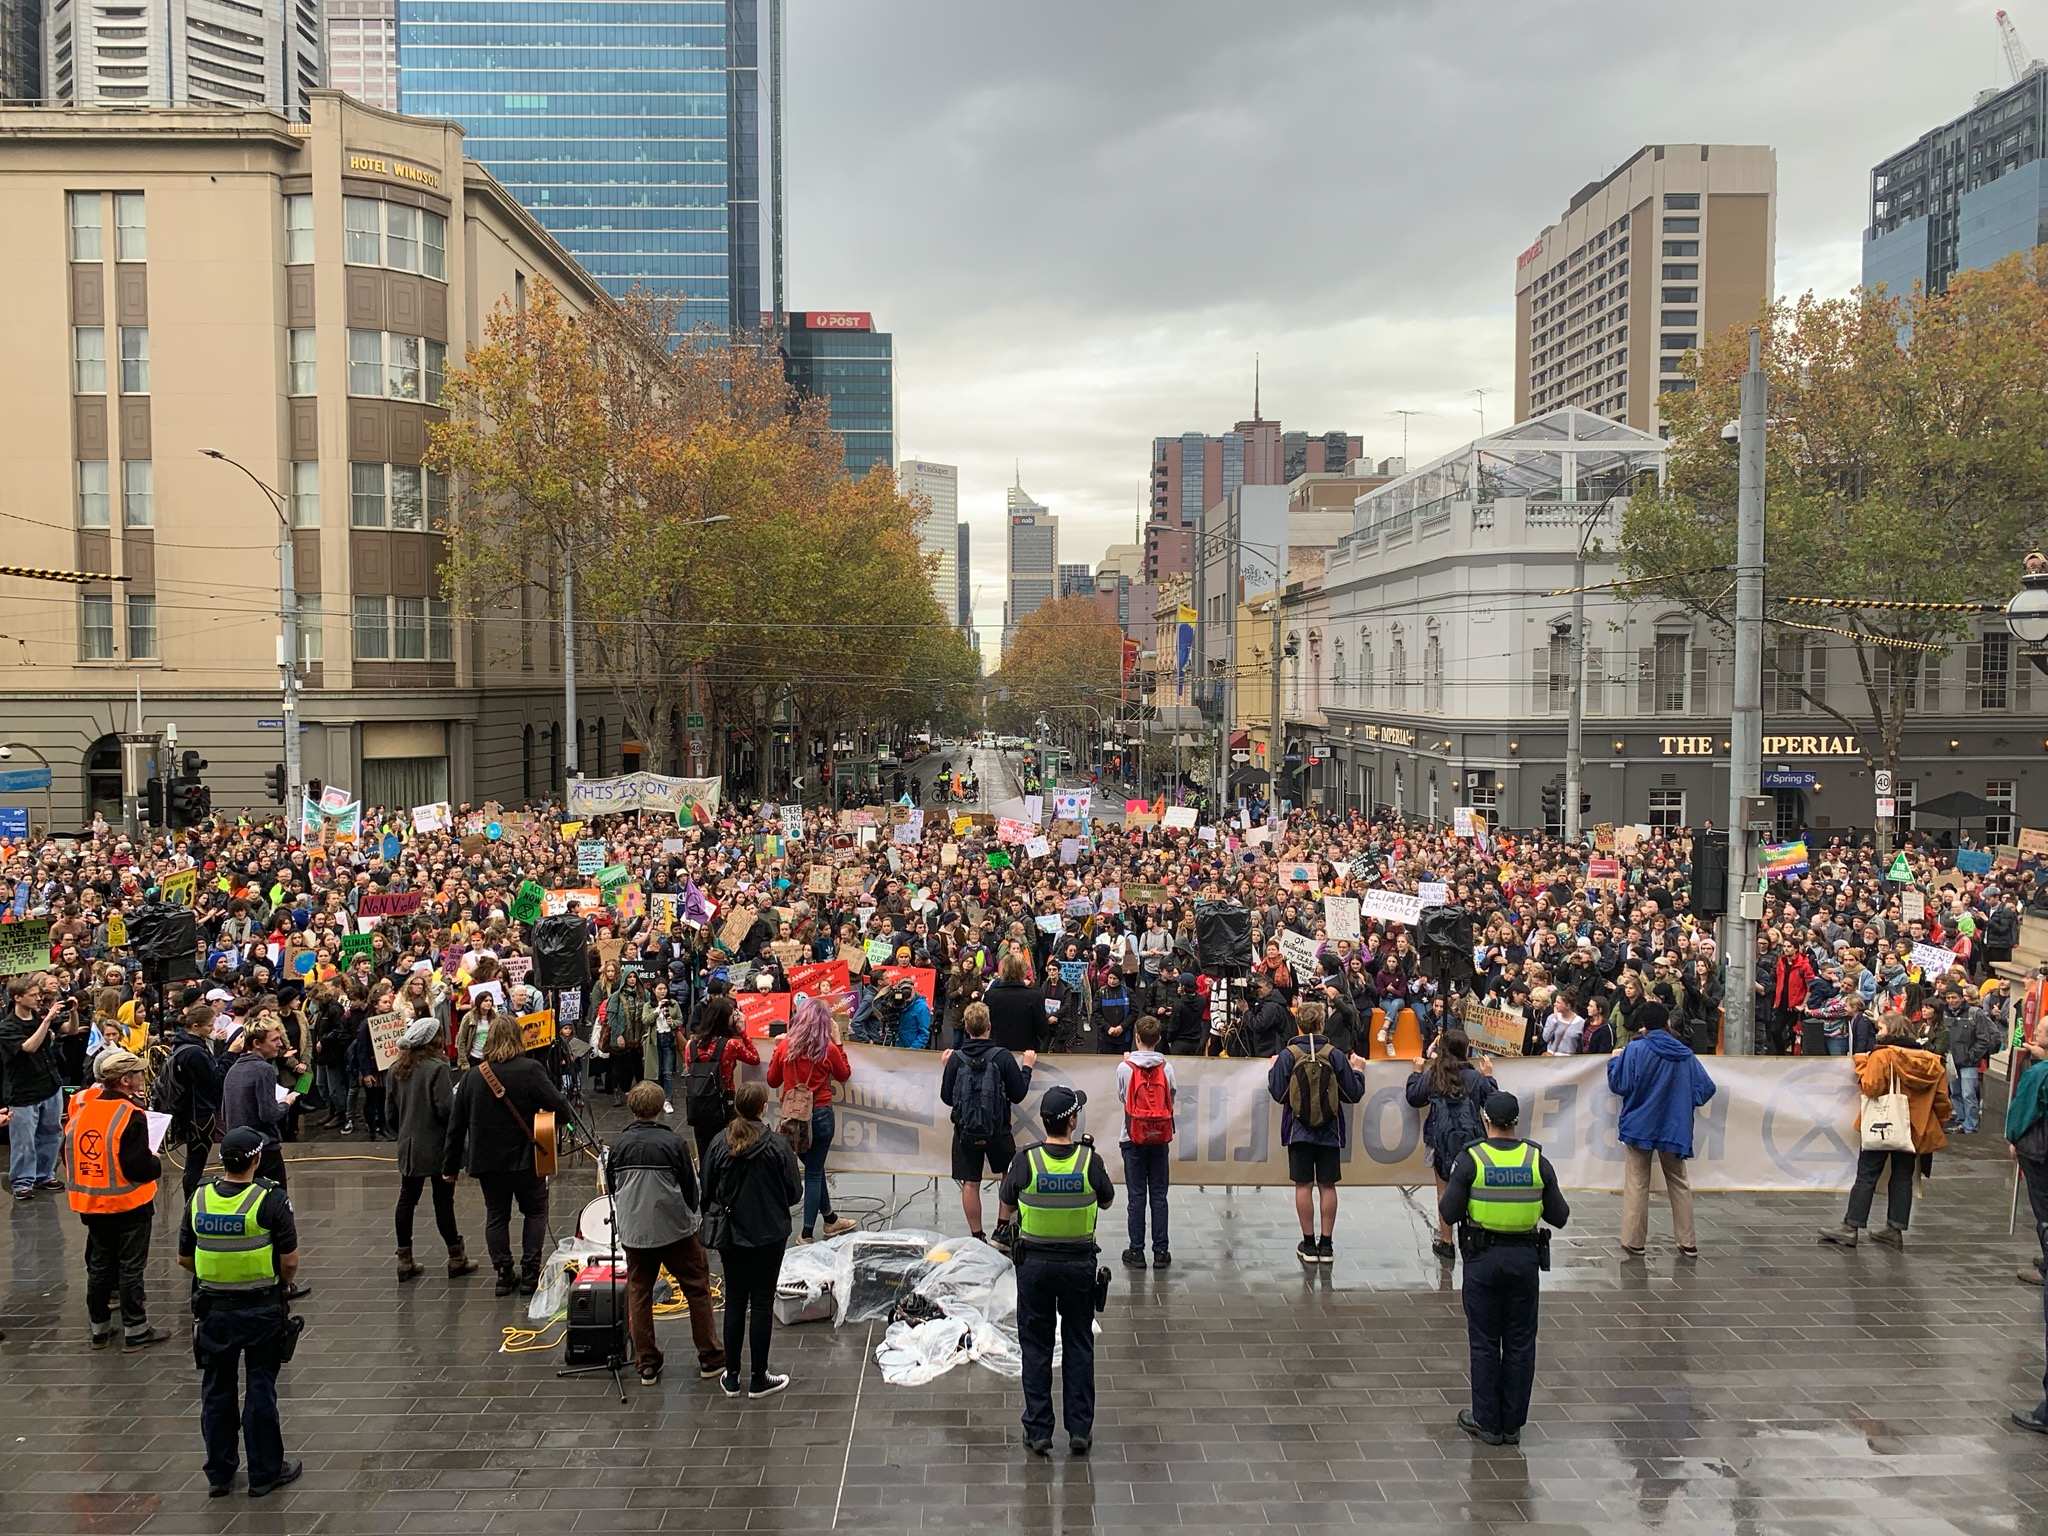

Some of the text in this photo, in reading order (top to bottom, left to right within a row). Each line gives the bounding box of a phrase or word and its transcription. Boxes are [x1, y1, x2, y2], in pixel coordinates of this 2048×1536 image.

[351, 156, 439, 189] HOTEL WINDSOR
[829, 316, 861, 327] POST
[1658, 736, 1861, 755] THE PERIAL
[1772, 774, 1815, 785] Spring St
[1877, 778, 1889, 787] 40
[575, 781, 668, 800] THIS IS ON
[782, 806, 801, 815] THERE
[791, 814, 801, 822] NO
[1896, 862, 1907, 871] THE
[1891, 870, 1912, 880] GREENS
[529, 885, 541, 894] ACT
[524, 892, 540, 902] NOW
[1367, 891, 1421, 908] CLIMATE
[1365, 901, 1419, 917] EMERGENCY
[1294, 936, 1306, 946] OK
[18, 956, 38, 966] EAT
[1468, 1005, 1505, 1018] PREDICTED
[370, 1016, 389, 1027] YOU'LL
[392, 1028, 406, 1038] DIE
[1486, 1169, 1531, 1184] Police
[1039, 1177, 1082, 1190] Police
[196, 1216, 243, 1232] Police
